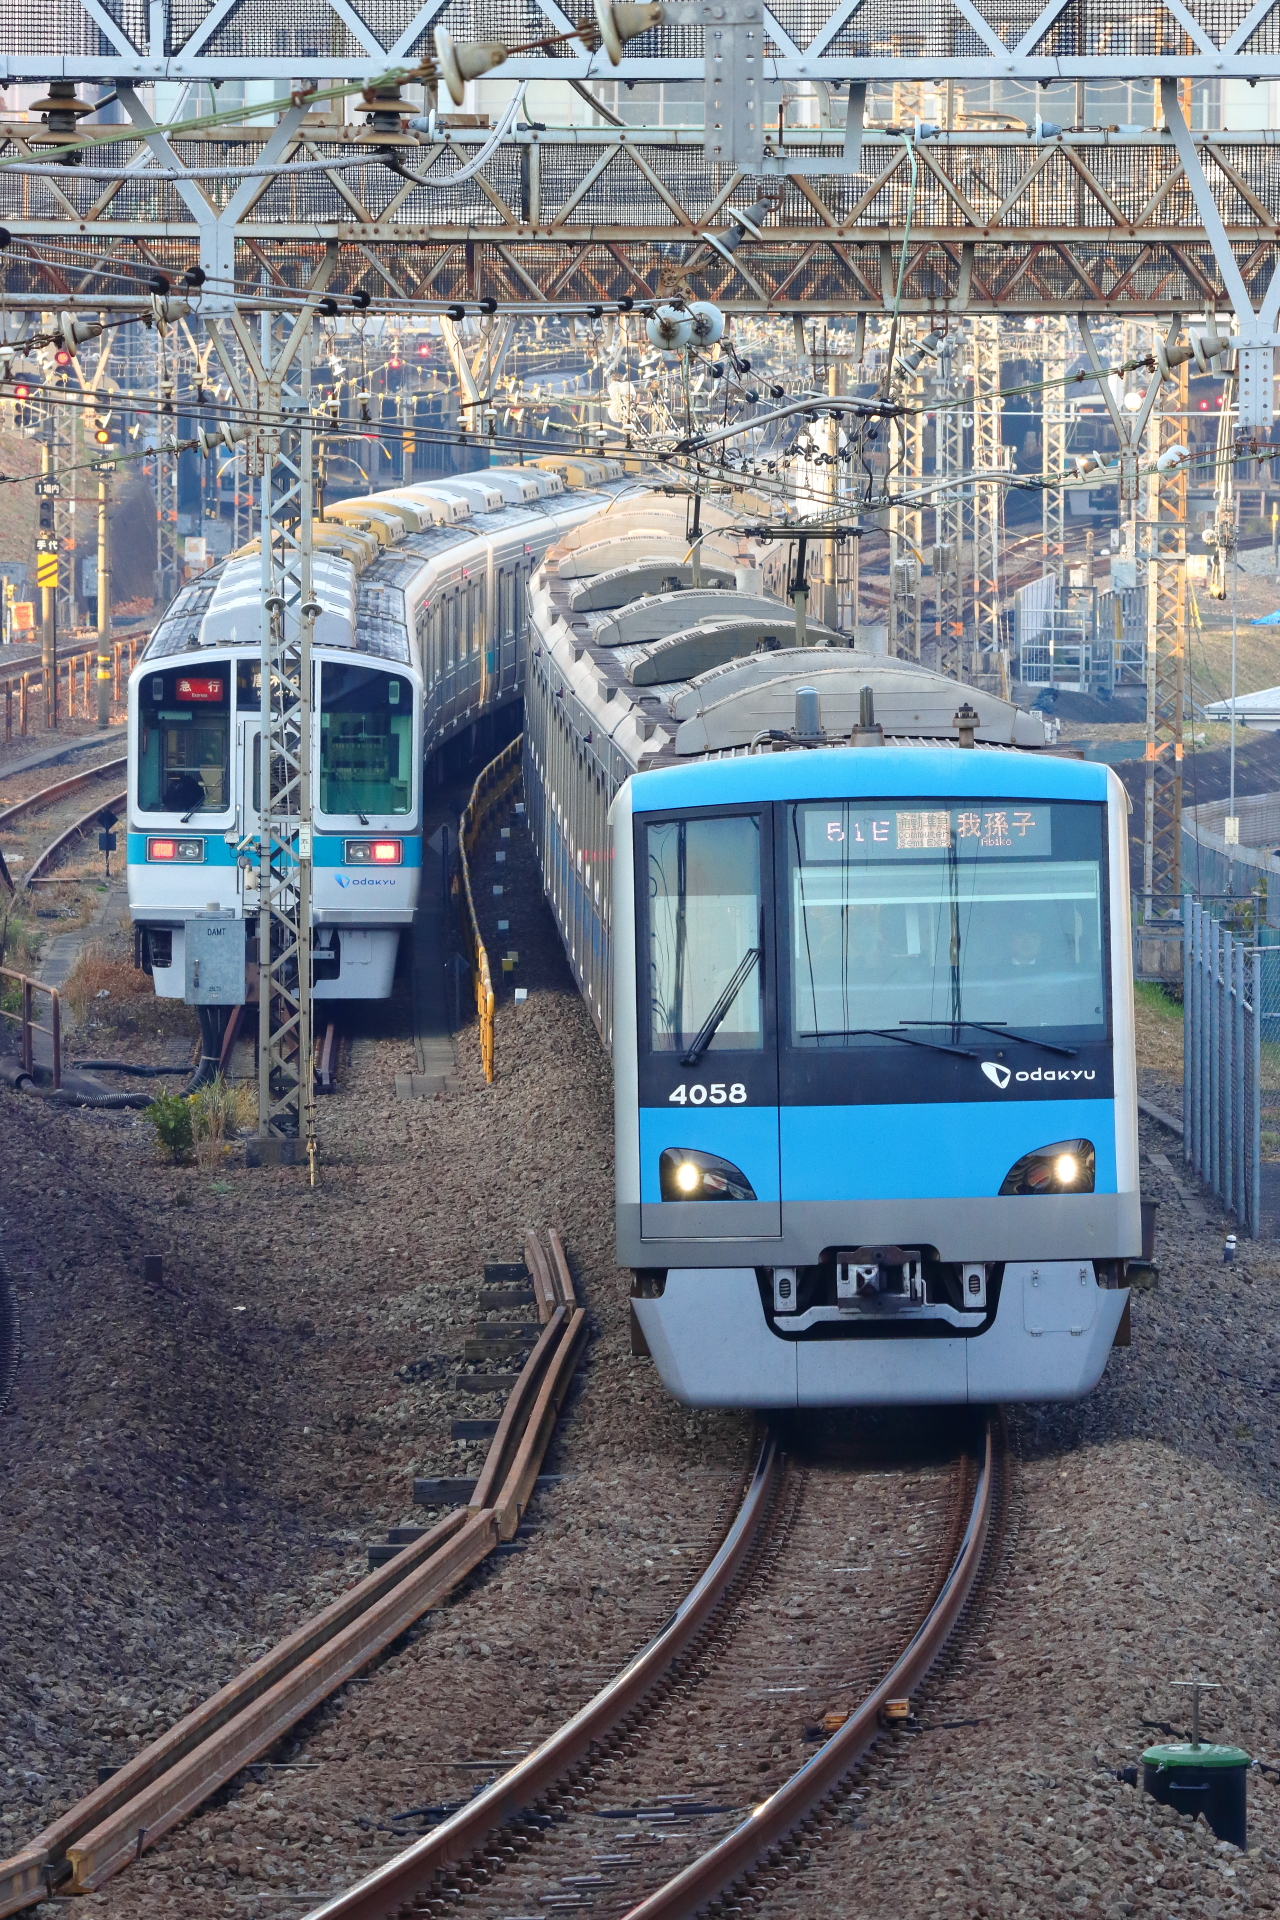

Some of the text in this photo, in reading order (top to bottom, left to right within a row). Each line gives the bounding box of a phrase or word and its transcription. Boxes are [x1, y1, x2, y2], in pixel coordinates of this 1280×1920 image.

[180, 680, 220, 692] 急行
[898, 812, 949, 830] 通勤準急
[957, 811, 1036, 838] 我孫子
[899, 839, 925, 847] Semi
[981, 836, 1012, 846] Abiko
[351, 877, 396, 886] odakyu
[1015, 1067, 1096, 1082] odakyu
[668, 1083, 748, 1105] 4058
